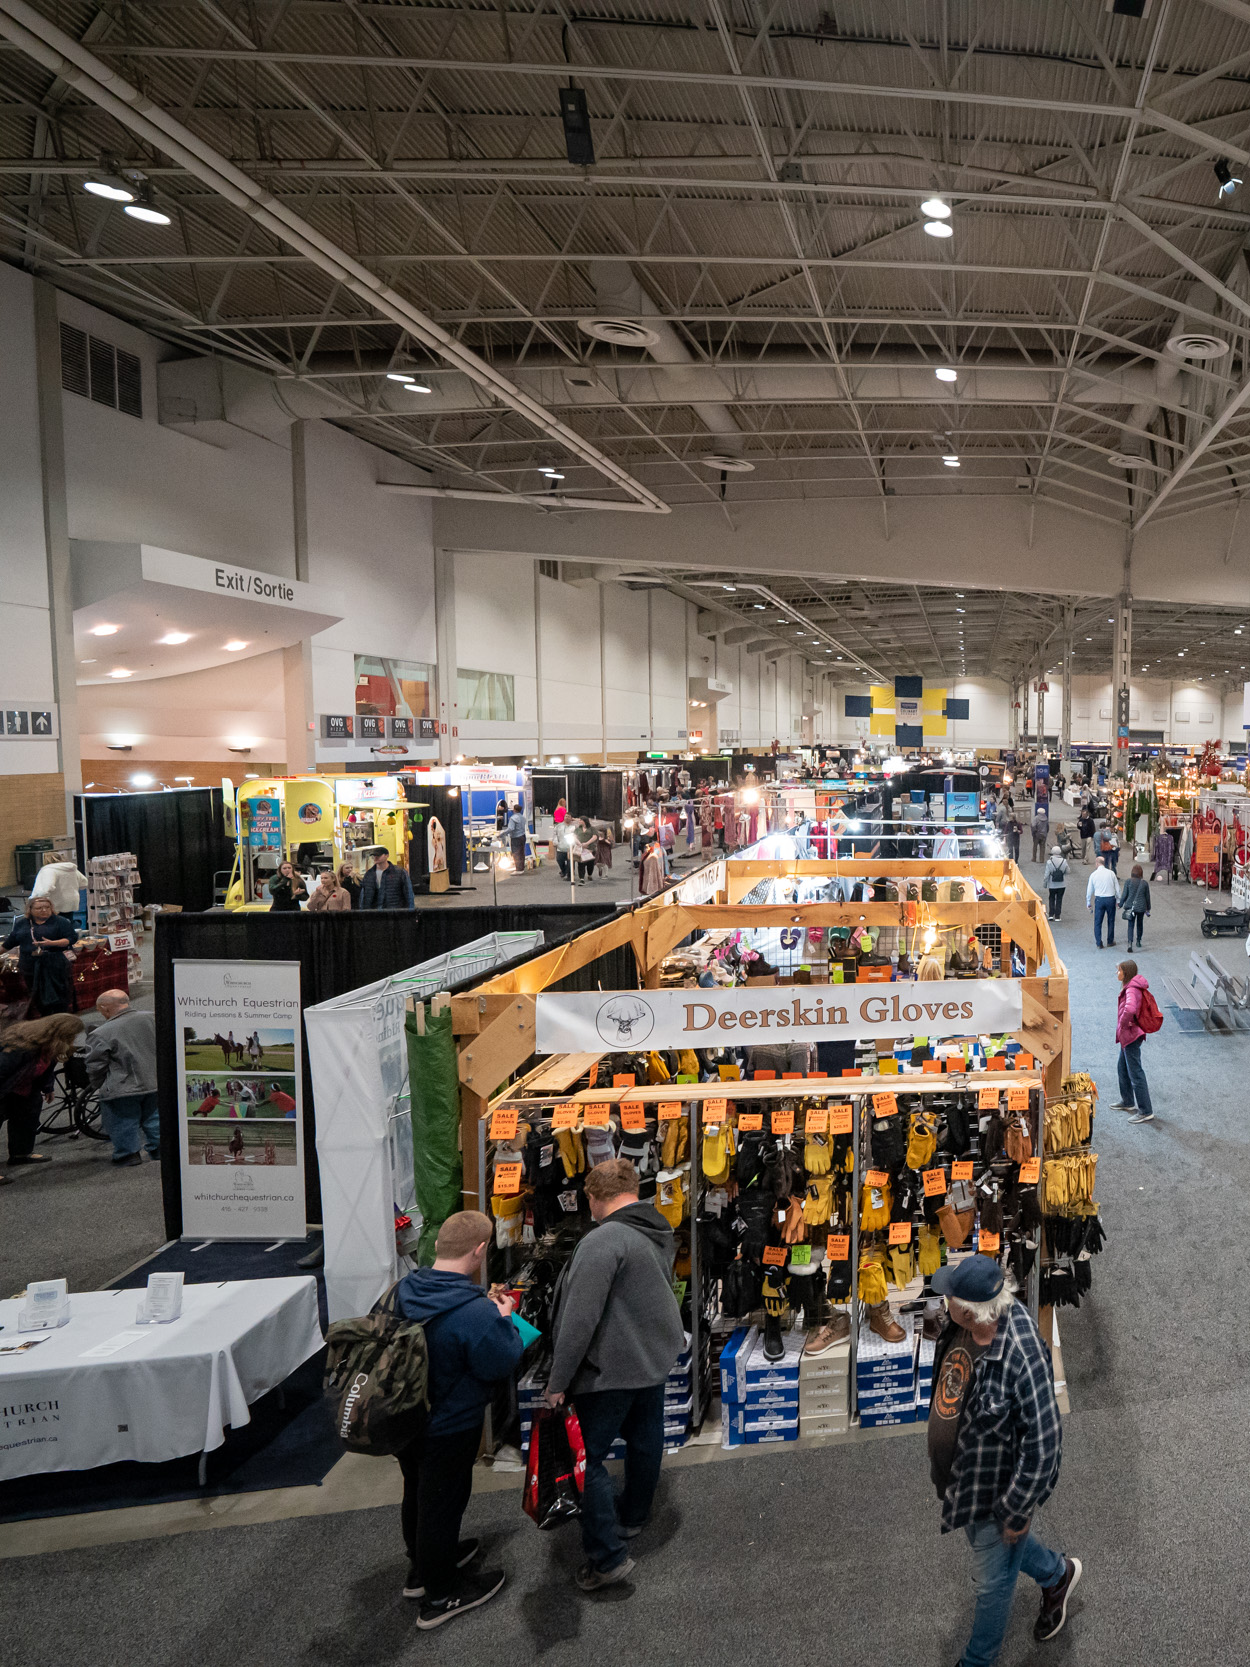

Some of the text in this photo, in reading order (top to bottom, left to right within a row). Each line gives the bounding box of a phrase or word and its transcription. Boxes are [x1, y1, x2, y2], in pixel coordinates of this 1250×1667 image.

[177, 997, 299, 1009] Whitchurch Equestrian
[185, 1011, 206, 1019] Riding
[682, 995, 974, 1031] Deerskin Gloves
[194, 1193, 294, 1202] whitchurchequestrian.ca
[340, 1372, 369, 1438] Columbia
